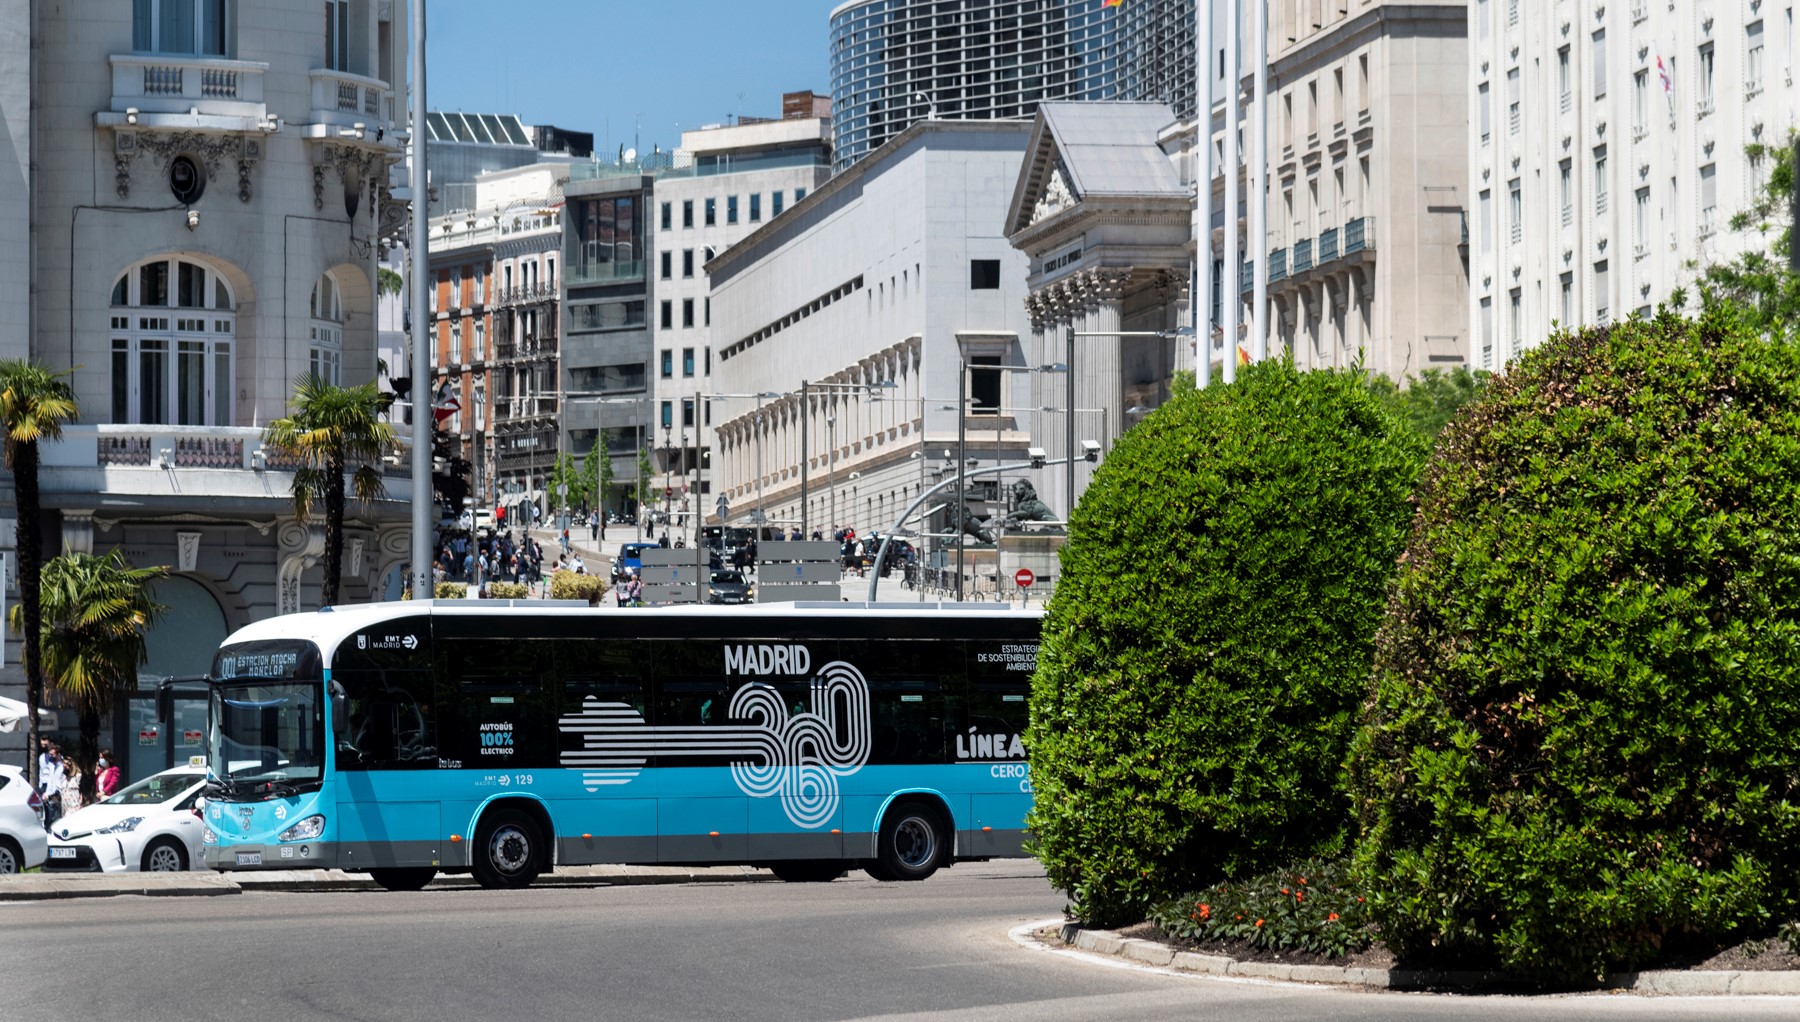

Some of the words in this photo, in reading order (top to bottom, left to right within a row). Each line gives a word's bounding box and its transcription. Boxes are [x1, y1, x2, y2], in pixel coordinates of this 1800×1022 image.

[1002, 645, 1040, 653] ESTRATEGI
[724, 645, 811, 675] MADRID
[978, 654, 987, 662] DE
[222, 657, 236, 678] 001
[238, 655, 269, 667] ESTACION
[270, 653, 297, 665] ATOCHA
[248, 665, 284, 677] MONCLOA
[480, 721, 513, 731] AUTOBÚS
[480, 732, 514, 747] 100%
[956, 725, 1026, 758] LÍNEA
[990, 764, 1025, 778] CERO
[515, 775, 533, 785] 129
[282, 848, 292, 857] SP
